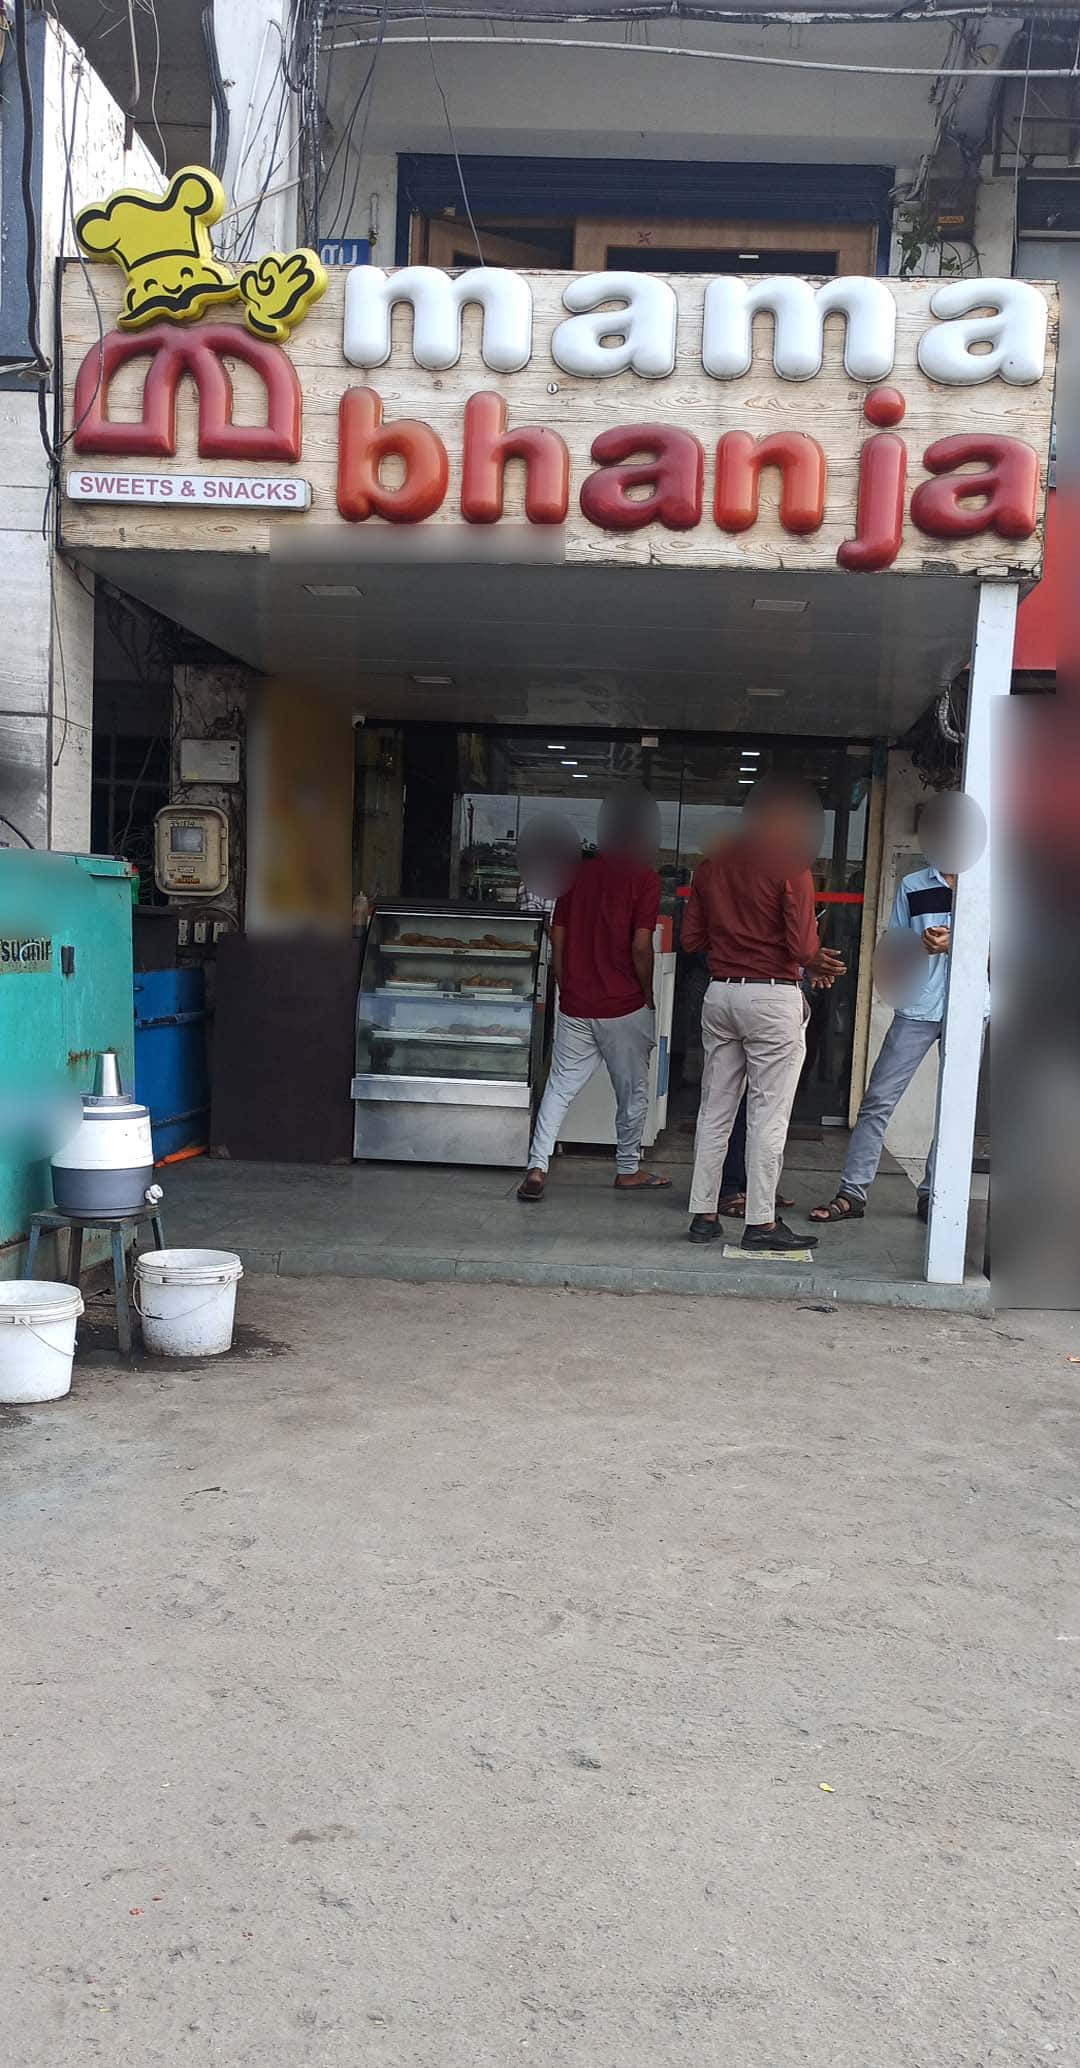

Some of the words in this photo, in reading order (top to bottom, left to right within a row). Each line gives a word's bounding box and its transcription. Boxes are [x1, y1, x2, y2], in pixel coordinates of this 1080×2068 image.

[343, 264, 1048, 386] mama
[79, 476, 174, 497] SWEETS
[180, 480, 196, 498] &
[203, 480, 297, 501] SNACKS
[337, 386, 1039, 572] bhanja
